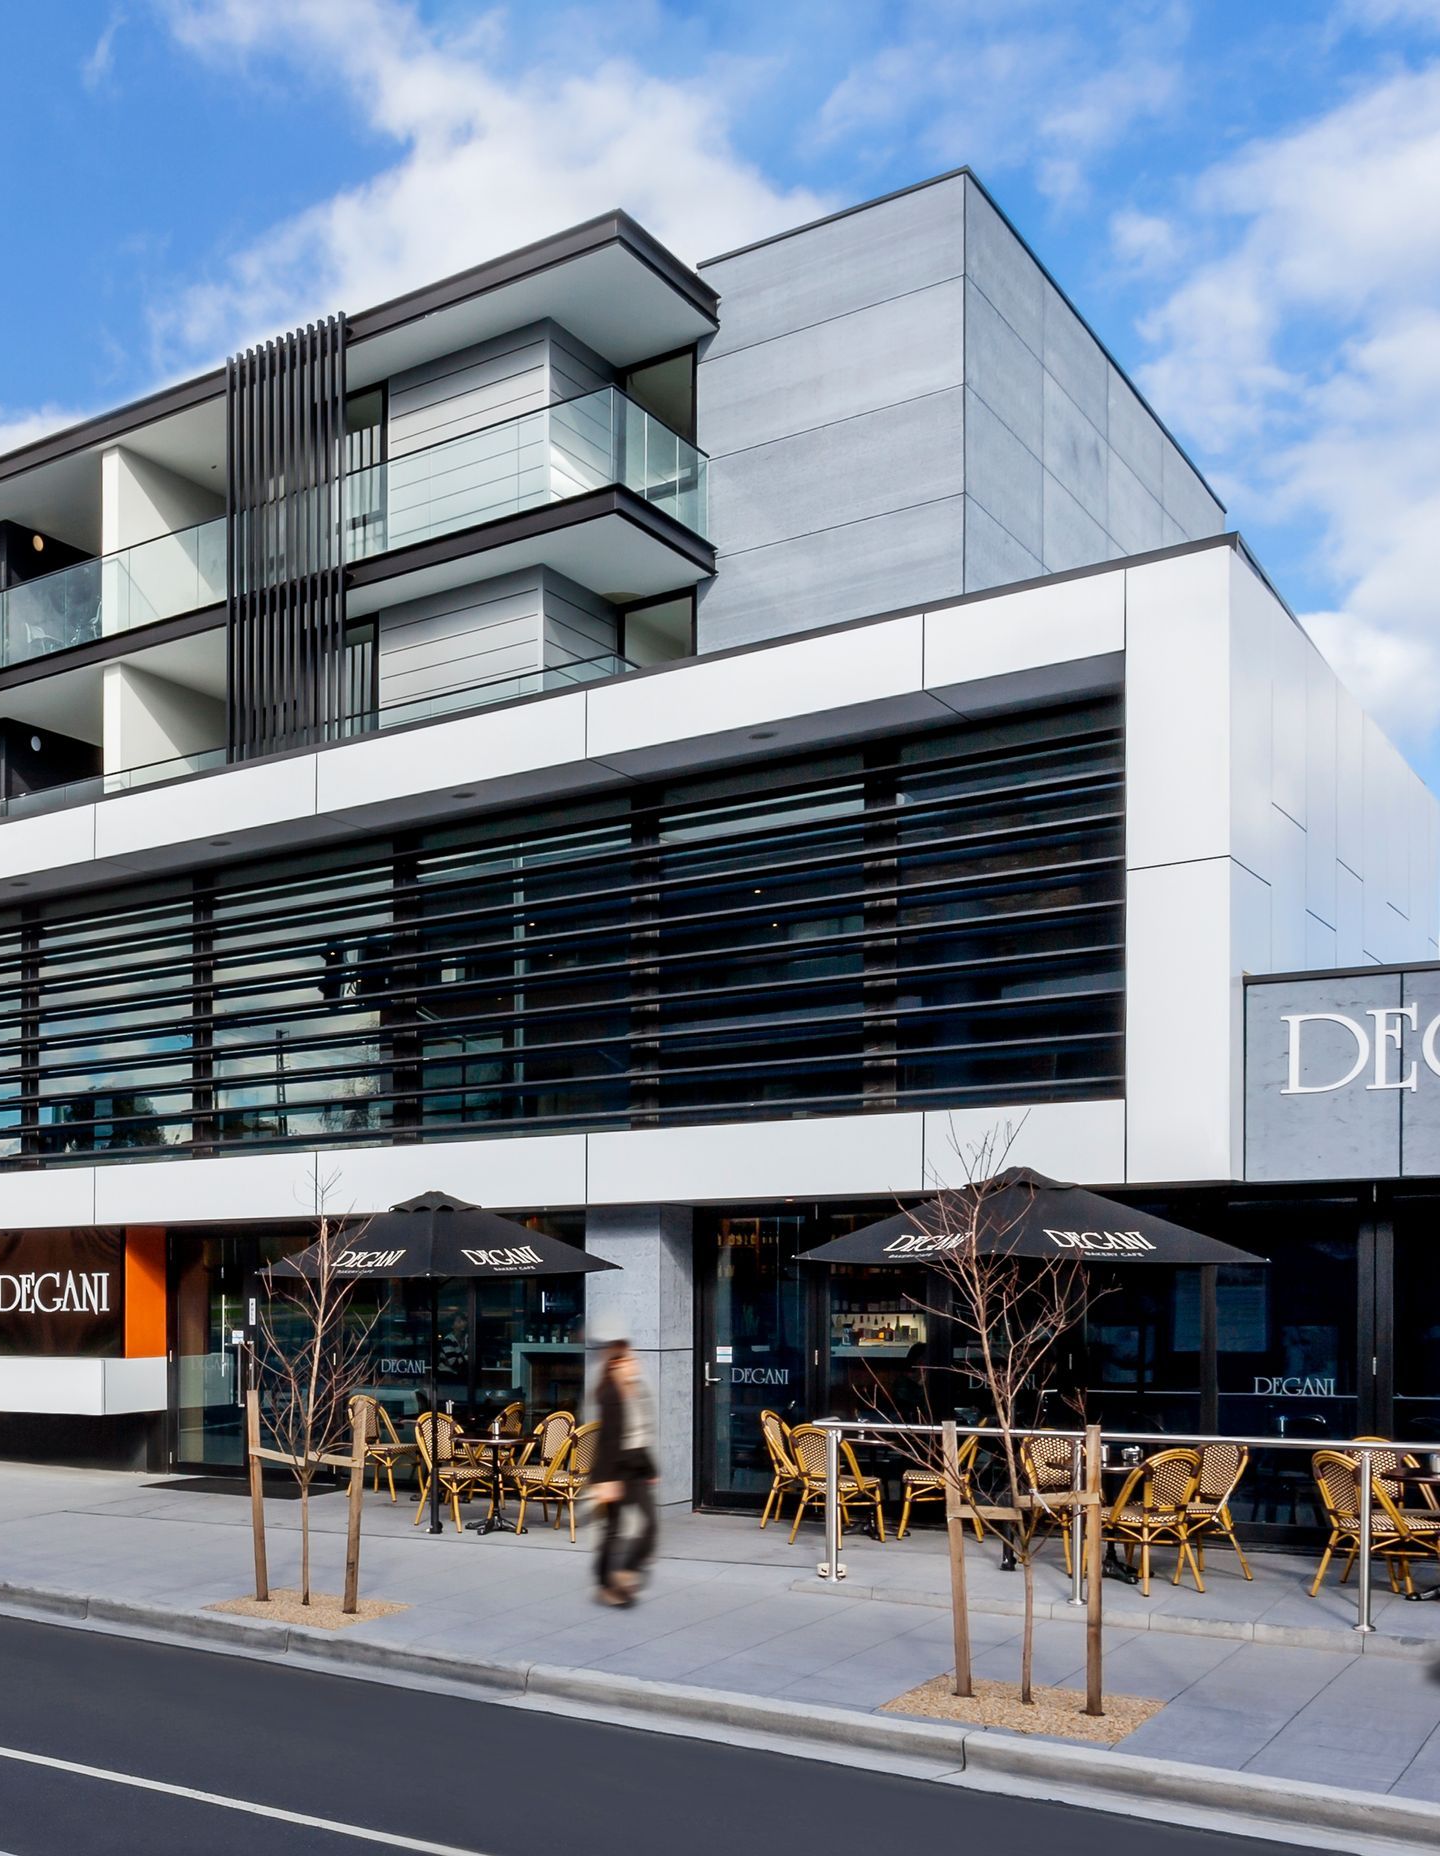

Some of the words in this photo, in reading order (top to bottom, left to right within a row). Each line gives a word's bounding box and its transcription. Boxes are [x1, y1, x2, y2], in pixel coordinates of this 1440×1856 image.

[1042, 1229, 1157, 1250] DEGANI
[330, 1249, 407, 1268] DEGANI
[461, 1245, 544, 1265] DEGANI
[381, 1359, 426, 1374] DEGANI
[731, 1367, 789, 1385] DEGANI
[1254, 1376, 1336, 1397] DEGANI
